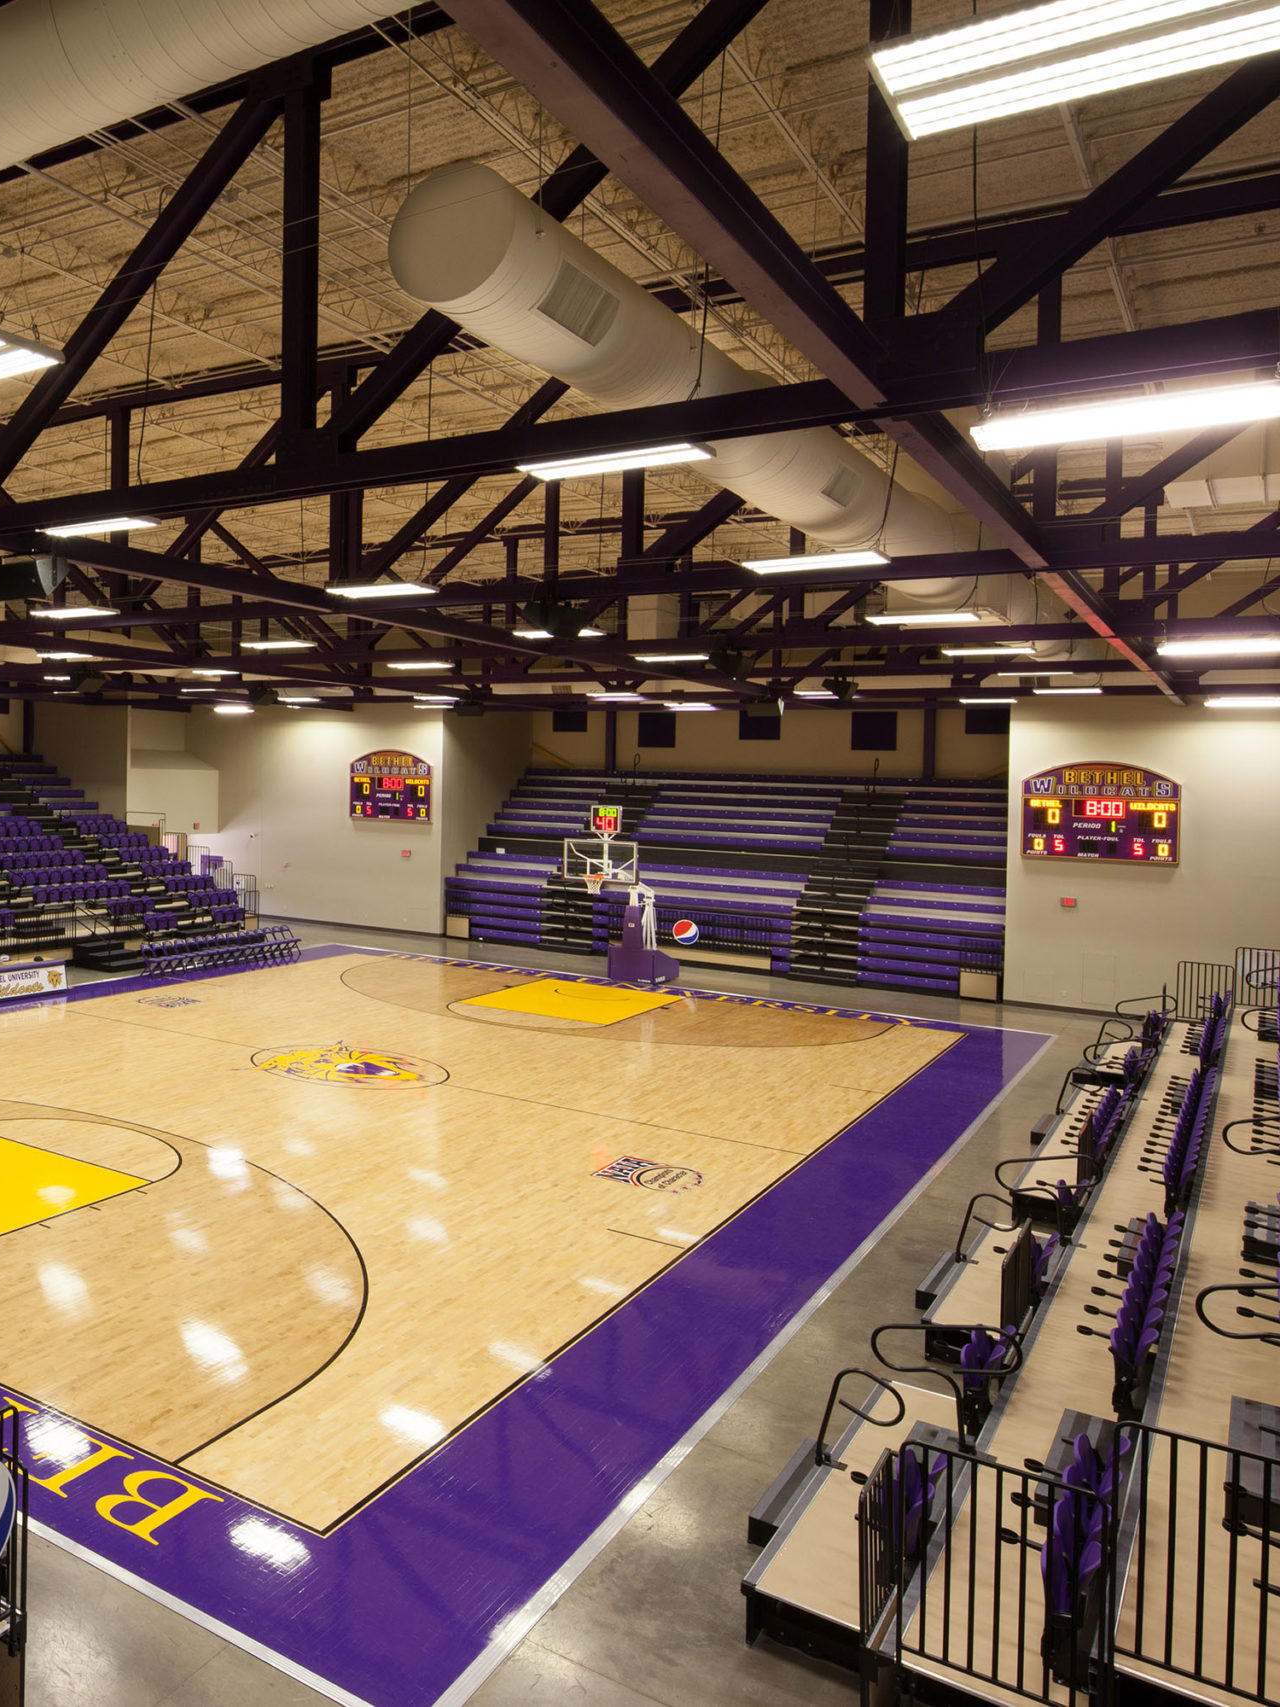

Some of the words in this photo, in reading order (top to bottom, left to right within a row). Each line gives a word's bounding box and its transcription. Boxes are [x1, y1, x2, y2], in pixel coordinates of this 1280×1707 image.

[371, 756, 414, 766] BETHEL
[354, 761, 428, 775] WILDCATS
[382, 777, 403, 789] 8:00
[1063, 769, 1146, 786] BETHEL
[363, 783, 370, 794] 0
[418, 785, 425, 797] 0
[1030, 776, 1173, 797] WILDCATS
[356, 805, 362, 814] 0
[1029, 799, 1063, 808] BETHEL
[1086, 800, 1124, 817] 8:00
[1129, 802, 1176, 812] WILDCATS
[366, 806, 373, 815] 5
[407, 807, 413, 817] 5
[420, 808, 426, 817] 0
[1047, 808, 1060, 824] 0
[595, 816, 616, 832] 40
[1154, 812, 1167, 828] 0
[1111, 821, 1116, 833] 1
[1034, 838, 1044, 851] 0
[1054, 839, 1064, 852] 5
[1133, 843, 1144, 856] 5
[1157, 843, 1169, 857] 0
[7, 970, 40, 983] UNIVERSITY
